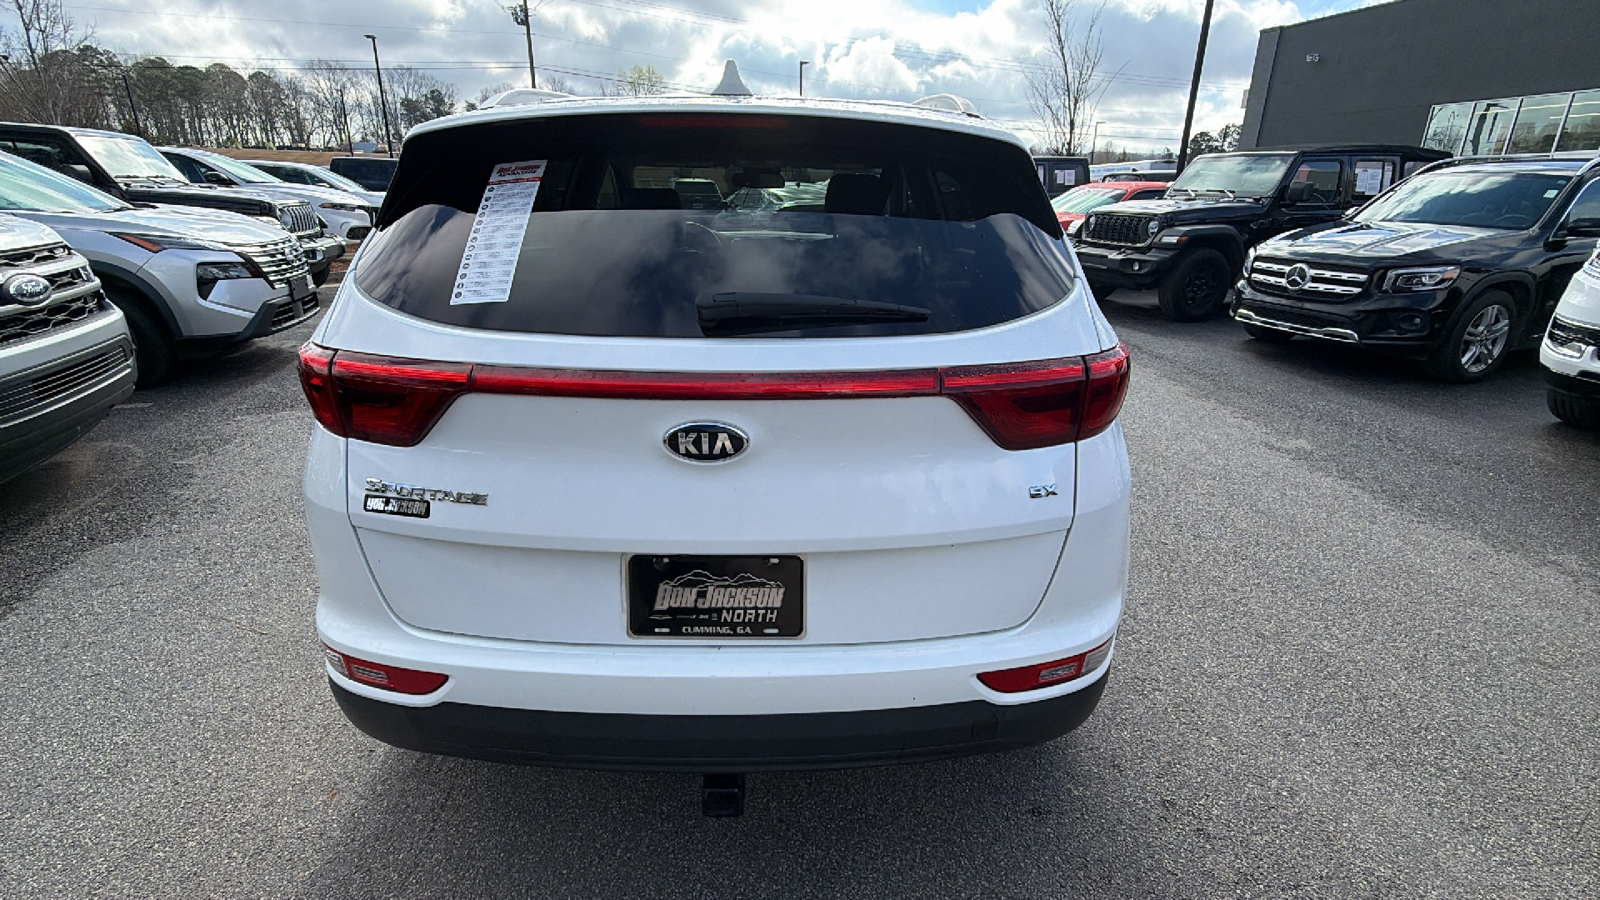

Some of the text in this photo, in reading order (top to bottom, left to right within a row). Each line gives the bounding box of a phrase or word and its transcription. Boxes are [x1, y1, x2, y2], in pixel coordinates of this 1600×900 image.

[21, 281, 44, 297] Ford
[678, 432, 735, 455] KIA
[364, 476, 489, 506] SPORTAGE
[1029, 483, 1059, 499] EX
[653, 584, 786, 610] DON JACKSON
[720, 609, 778, 623] NORTH
[681, 626, 752, 635] CUMMING, GA
